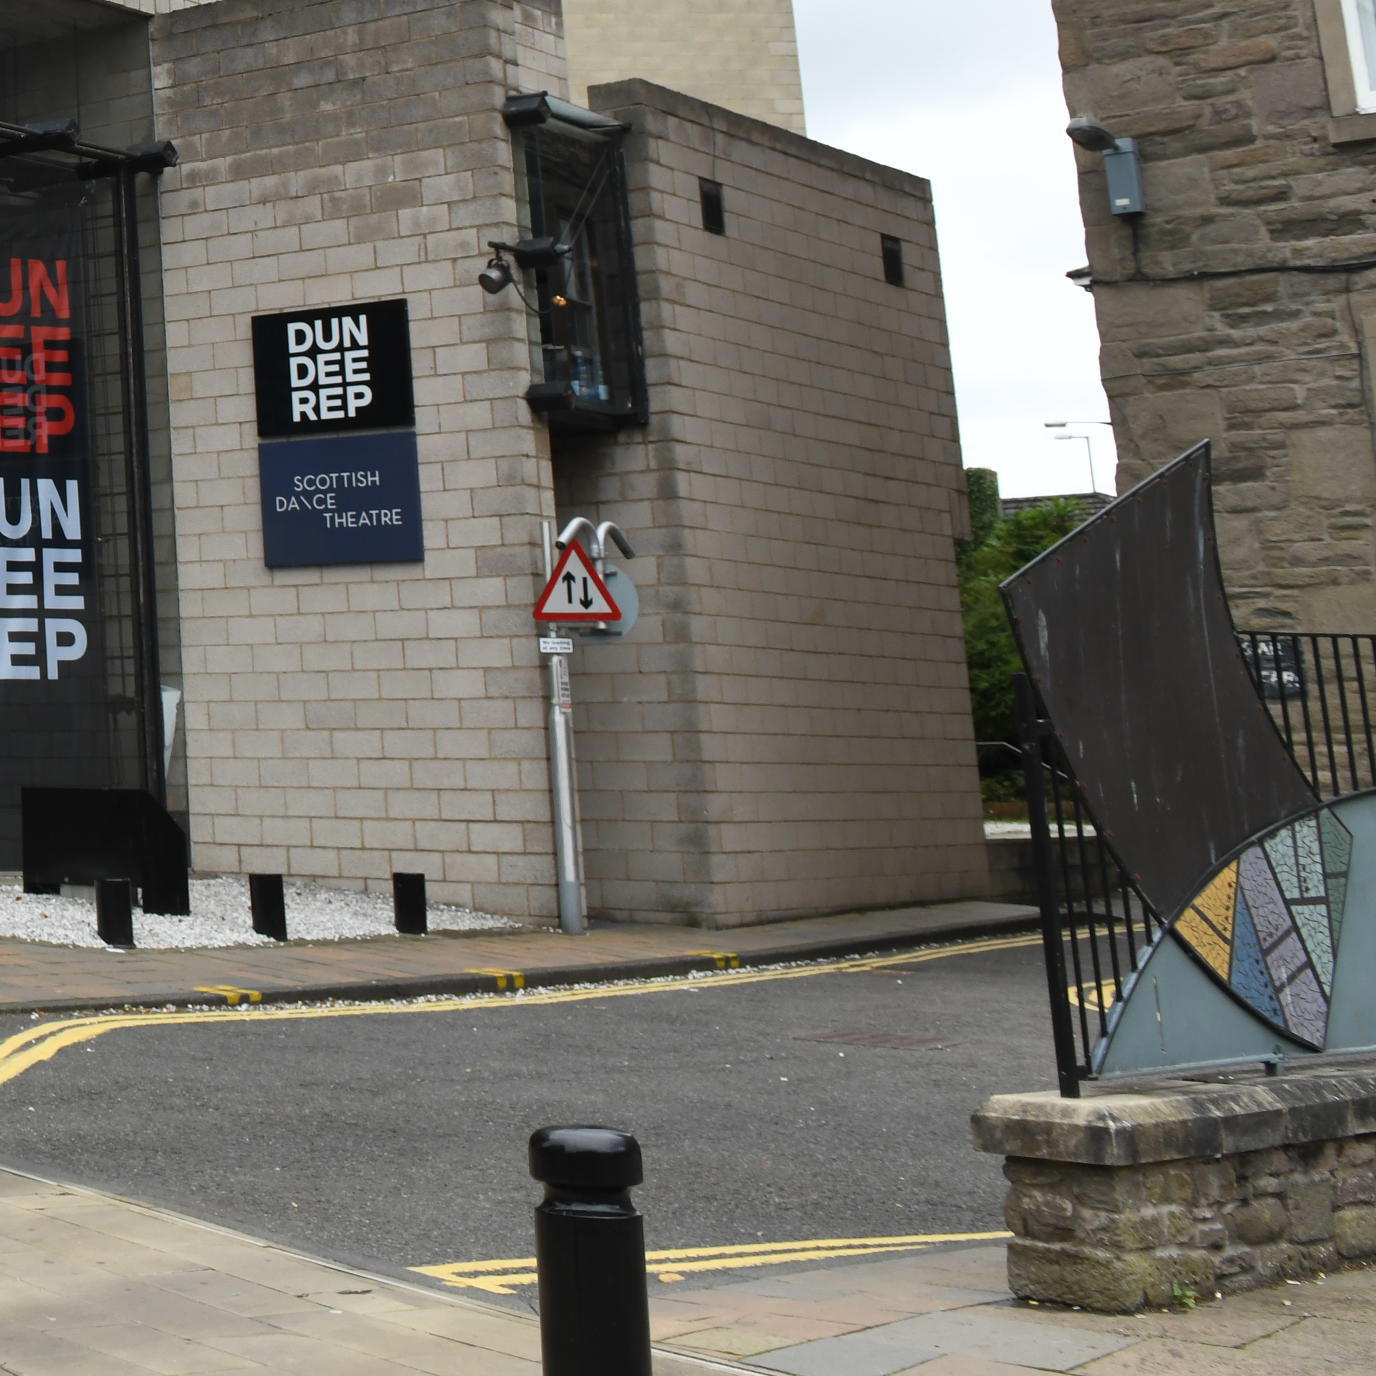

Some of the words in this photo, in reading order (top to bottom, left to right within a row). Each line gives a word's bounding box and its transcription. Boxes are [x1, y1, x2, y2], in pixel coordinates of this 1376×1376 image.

[286, 314, 369, 354] DUN
[289, 349, 371, 388] DEE
[291, 384, 373, 423] REP
[293, 470, 380, 492] SCOTTISH
[323, 508, 402, 528] THEATRE
